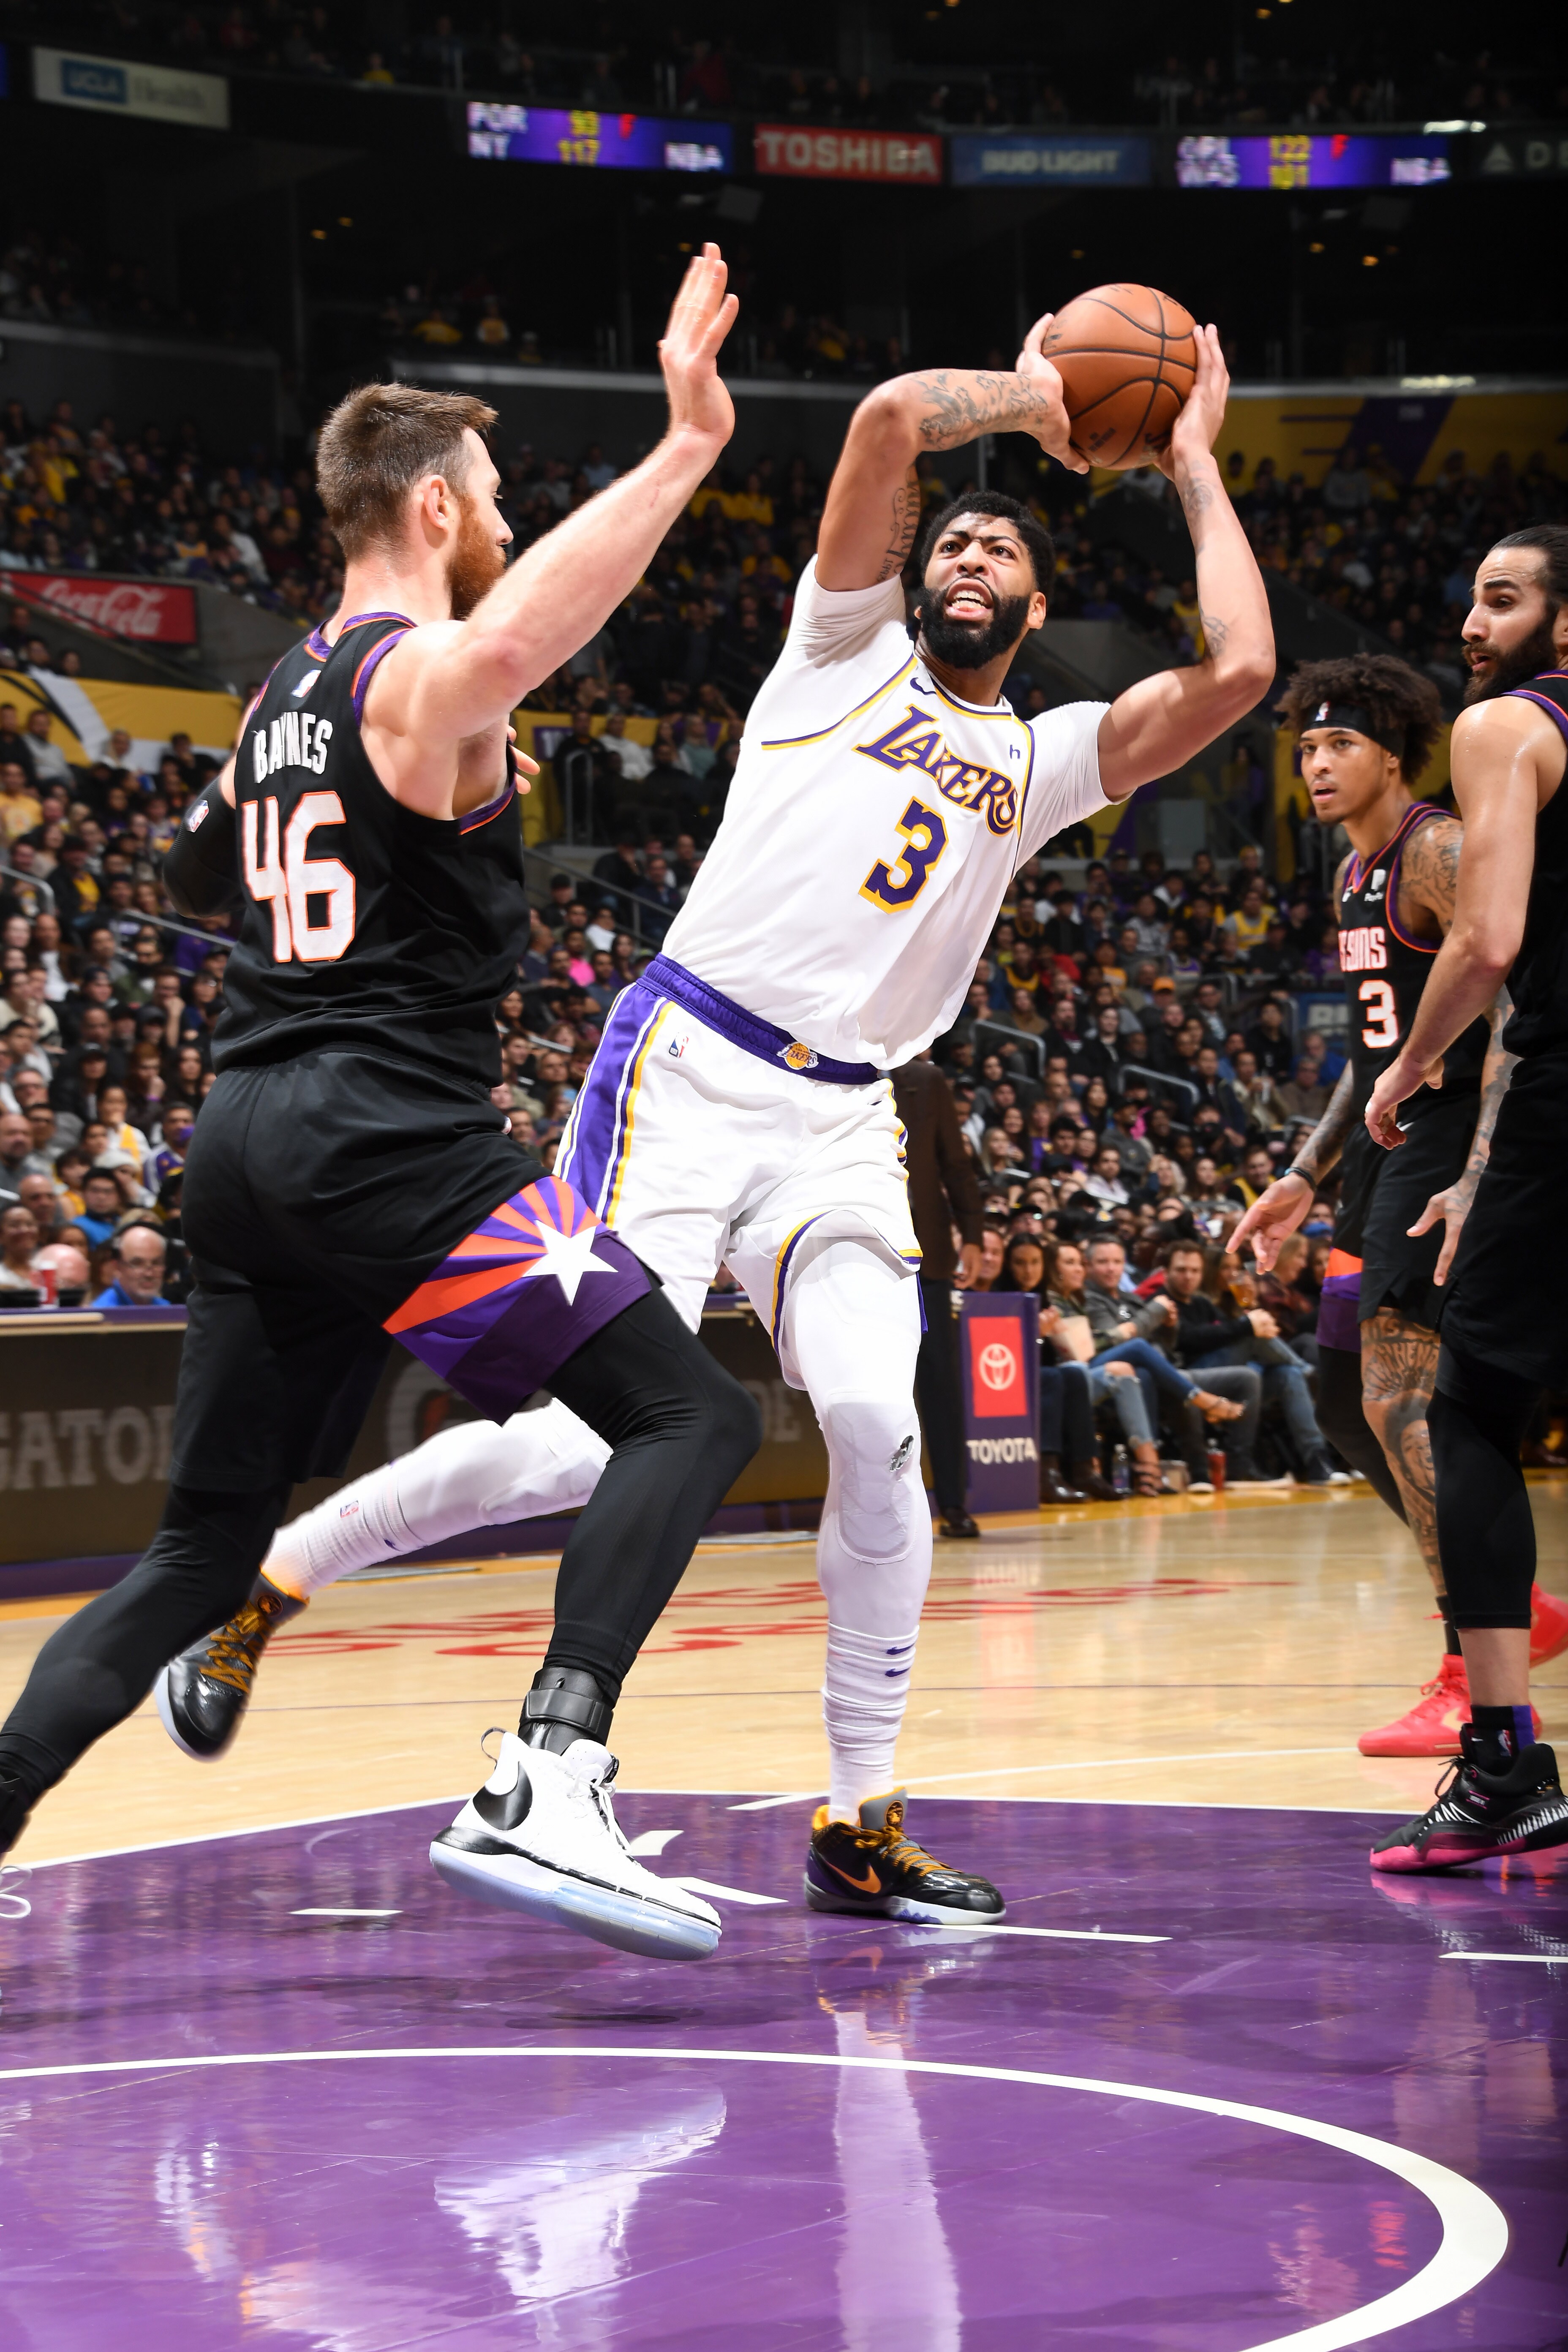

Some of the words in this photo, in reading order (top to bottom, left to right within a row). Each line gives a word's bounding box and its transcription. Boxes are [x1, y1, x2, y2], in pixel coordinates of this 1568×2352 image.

[760, 131, 939, 177] TOSHIBA
[982, 150, 1038, 174] BUD
[1041, 150, 1119, 174] LIGHT
[253, 711, 332, 784] BAYNES
[851, 703, 1018, 837] LAKERS
[242, 790, 356, 963] 46
[858, 796, 949, 914] 3
[1358, 980, 1399, 1048] 3
[966, 1437, 1038, 1465] TOYOTA
